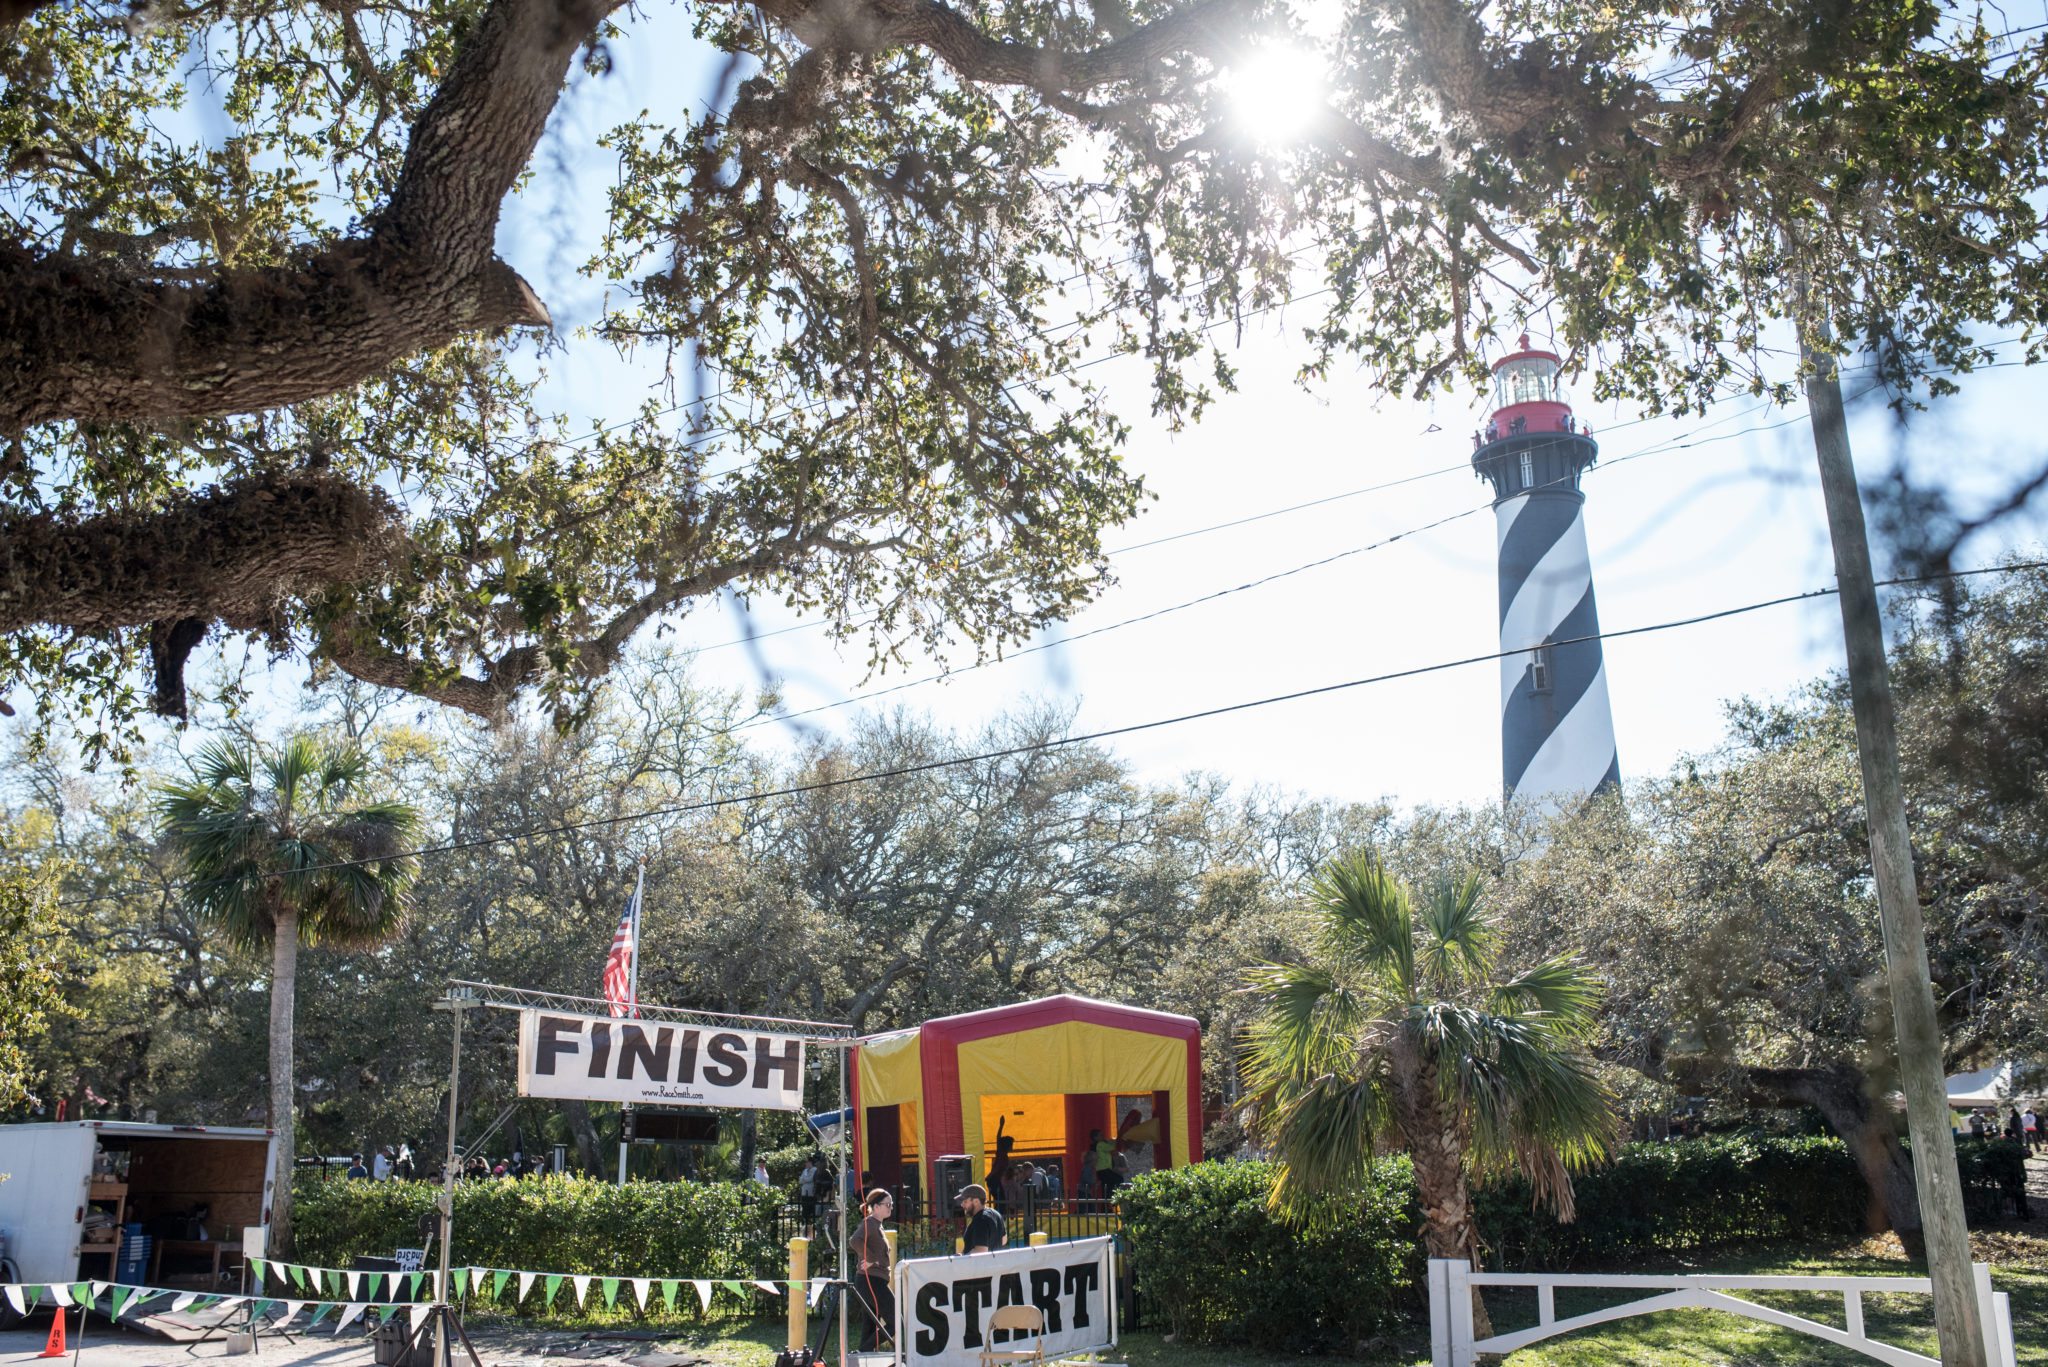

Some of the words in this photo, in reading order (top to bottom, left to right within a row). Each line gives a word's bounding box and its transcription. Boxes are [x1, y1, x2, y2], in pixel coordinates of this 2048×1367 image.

[536, 1016, 800, 1091] FINISH
[641, 1085, 704, 1100] www.RaceSmith.com
[915, 1261, 1099, 1357] START
